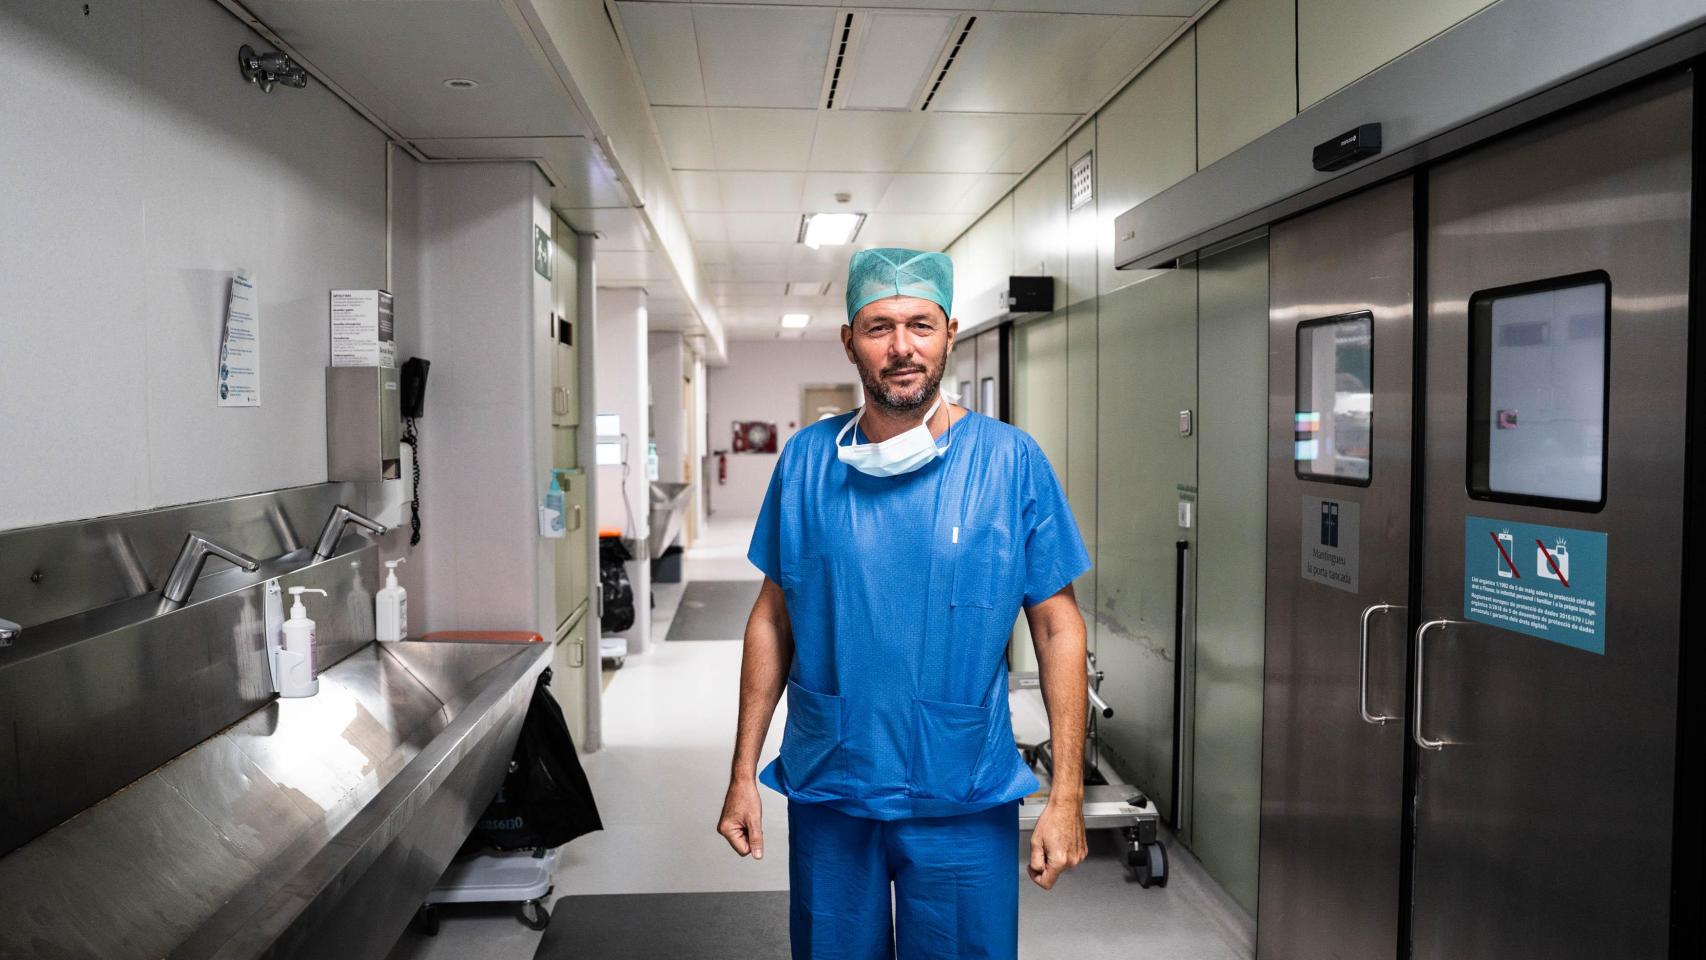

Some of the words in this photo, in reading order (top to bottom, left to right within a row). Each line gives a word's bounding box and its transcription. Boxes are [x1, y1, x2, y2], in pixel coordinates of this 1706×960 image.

[1313, 547, 1346, 566] Mantingueu
[1307, 560, 1313, 573] la
[1313, 566, 1328, 577] porta
[1328, 569, 1351, 584] tancada
[1554, 594, 1576, 604] protecció
[1544, 610, 1558, 618] dades
[1579, 626, 1595, 635] dades
